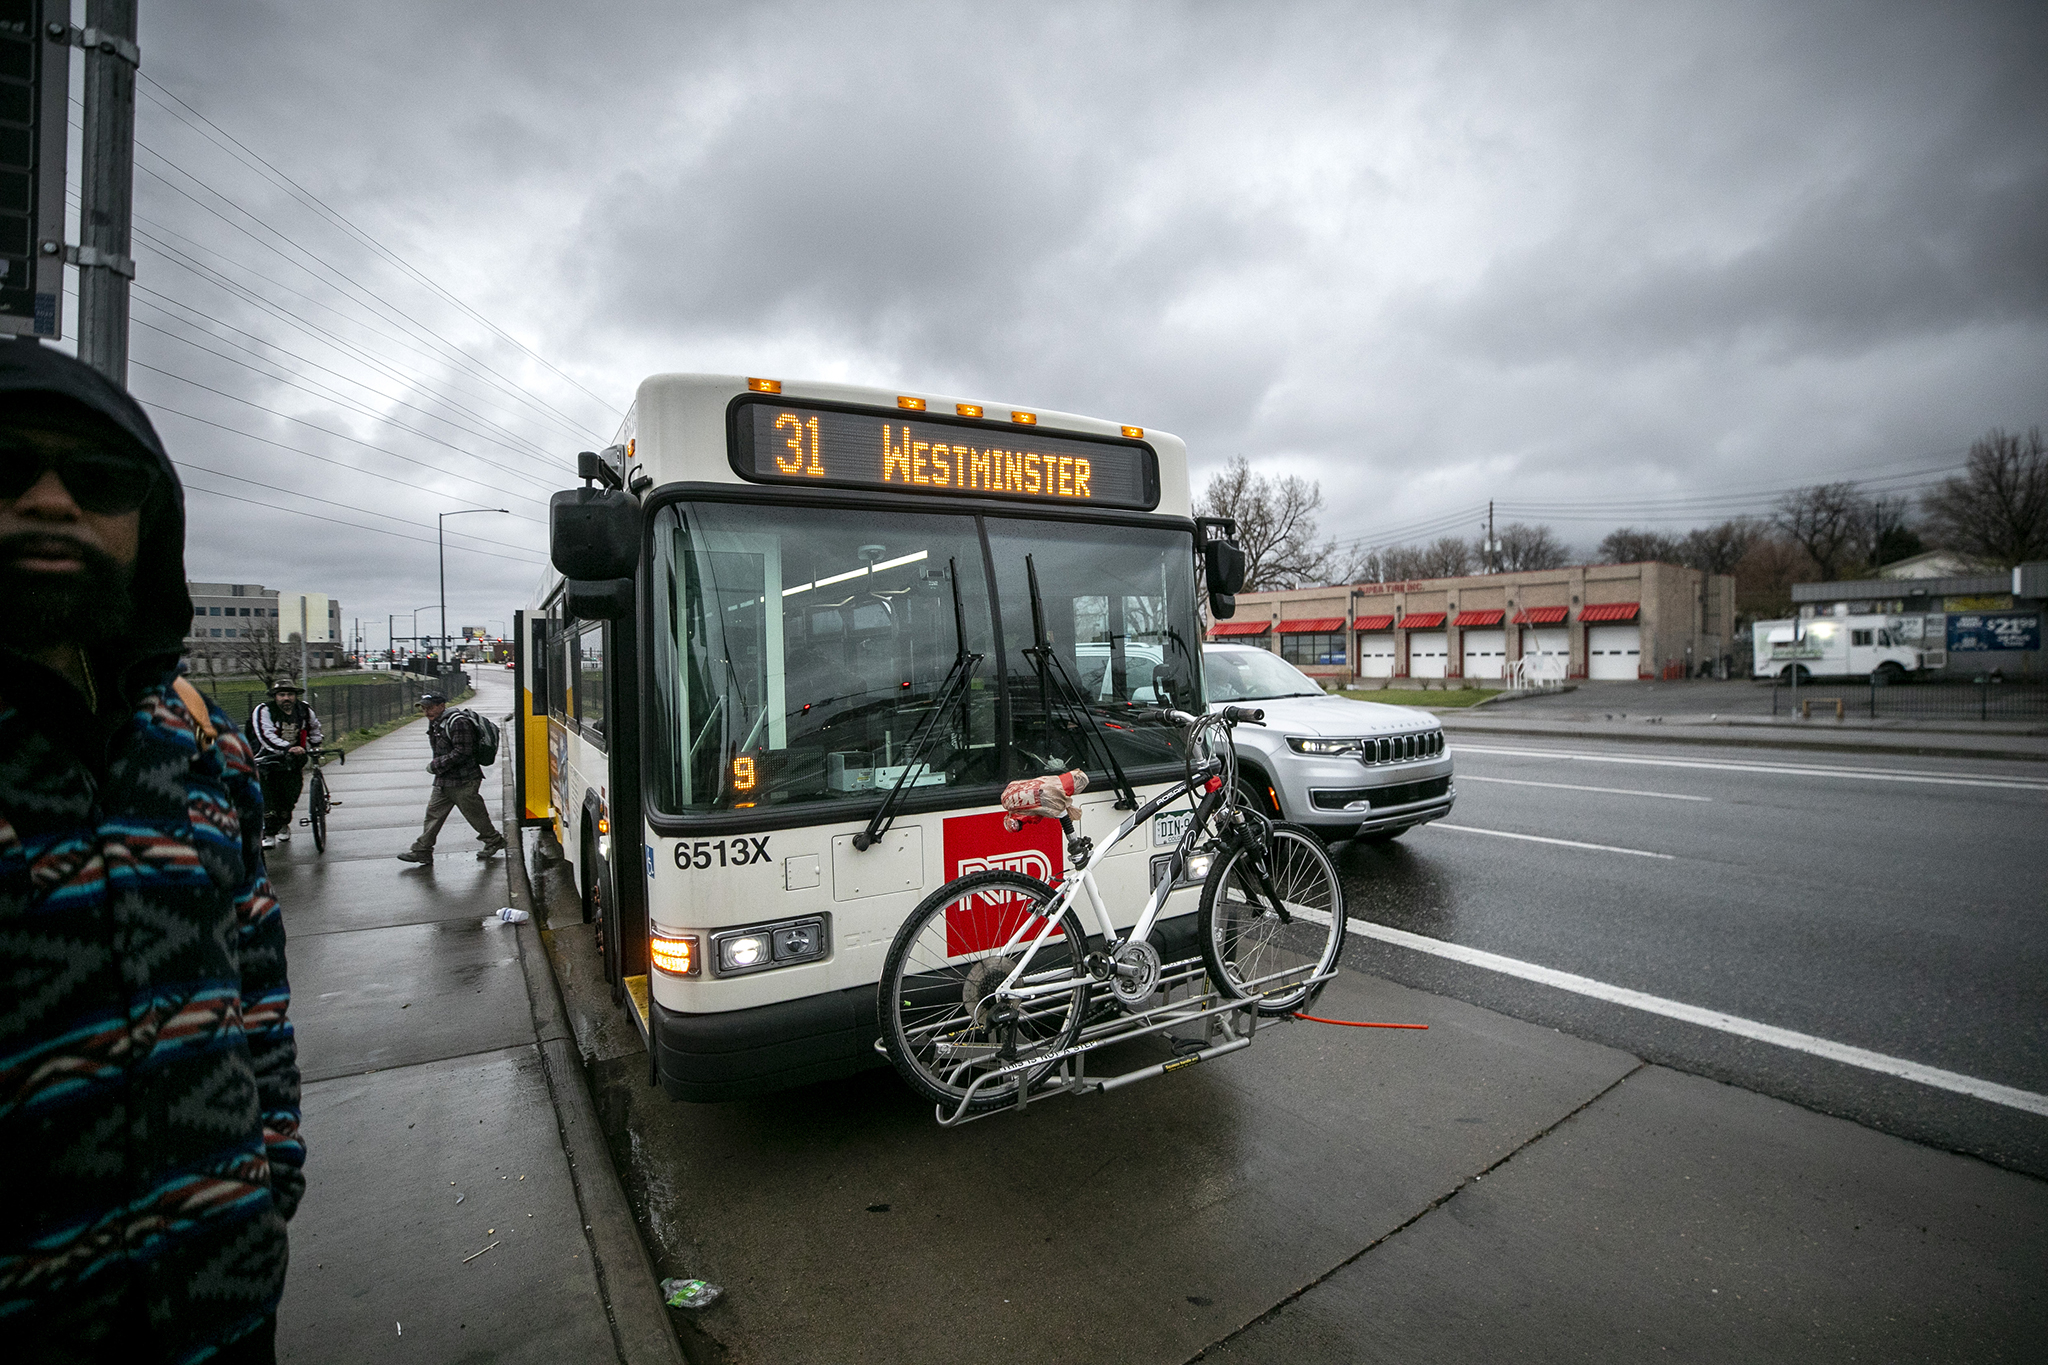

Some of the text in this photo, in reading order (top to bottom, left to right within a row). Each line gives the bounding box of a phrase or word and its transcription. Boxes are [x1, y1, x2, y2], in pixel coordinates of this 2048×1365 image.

[775, 413, 1091, 497] 31 WESTMINSTER
[733, 756, 755, 790] 9
[674, 836, 772, 870] 6513X
[958, 849, 1052, 912] RTD
